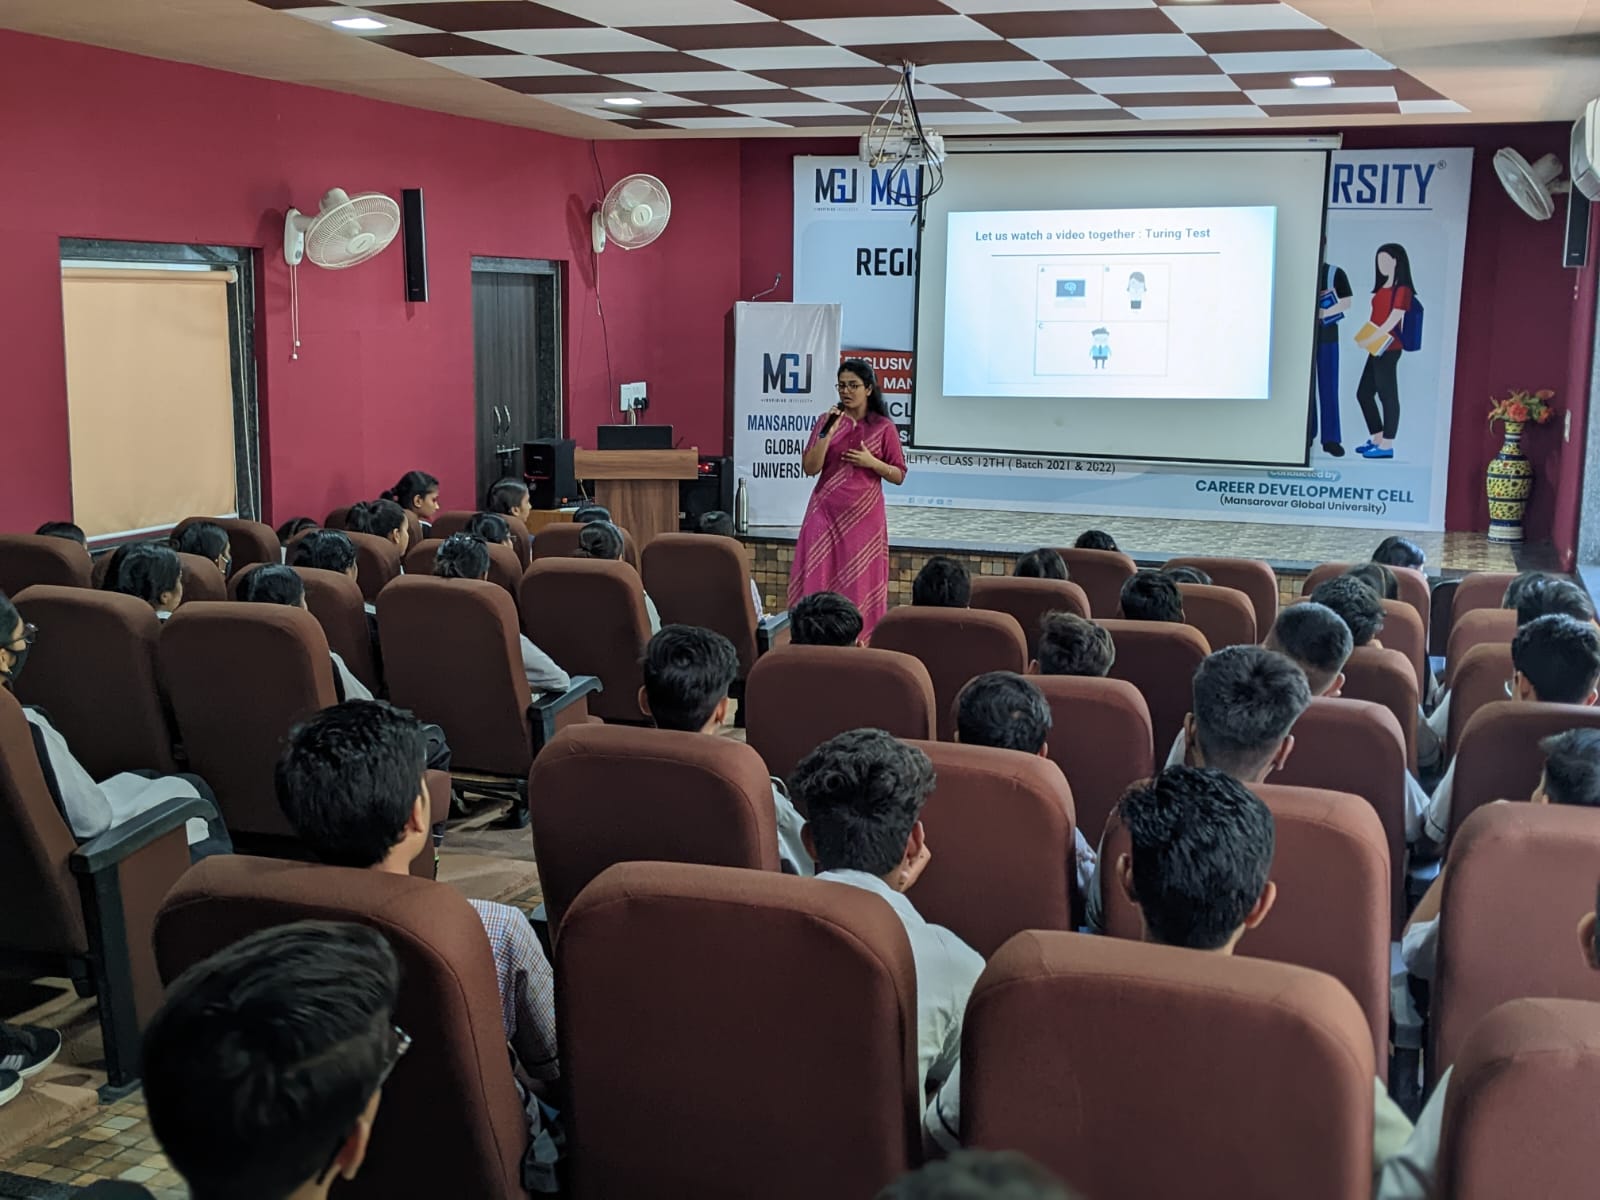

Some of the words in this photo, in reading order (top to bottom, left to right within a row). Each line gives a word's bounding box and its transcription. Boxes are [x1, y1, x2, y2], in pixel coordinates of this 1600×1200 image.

[870, 168, 919, 206] MA
[975, 231, 992, 242] Let
[995, 233, 1008, 241] us
[1011, 230, 1043, 241] watch
[1056, 229, 1085, 240] video
[1088, 229, 1136, 242] together
[1145, 228, 1182, 240] Turing
[1186, 228, 1211, 238] Test
[857, 247, 916, 277] REGI
[747, 414, 820, 431] MANSAROVA
[752, 462, 816, 478] UNIVERSI
[940, 455, 974, 467] CLASS
[977, 457, 1004, 468] 12TH
[1015, 459, 1043, 469] Batch
[1047, 460, 1070, 470] 2021
[1075, 461, 1083, 471] &
[1195, 479, 1255, 494] CAREER
[1258, 484, 1374, 501] DEVELOPMENT
[1377, 489, 1414, 503] CELL
[1220, 493, 1288, 508] (Mansarovar
[1290, 498, 1325, 510] Global
[1327, 501, 1387, 515] University)
